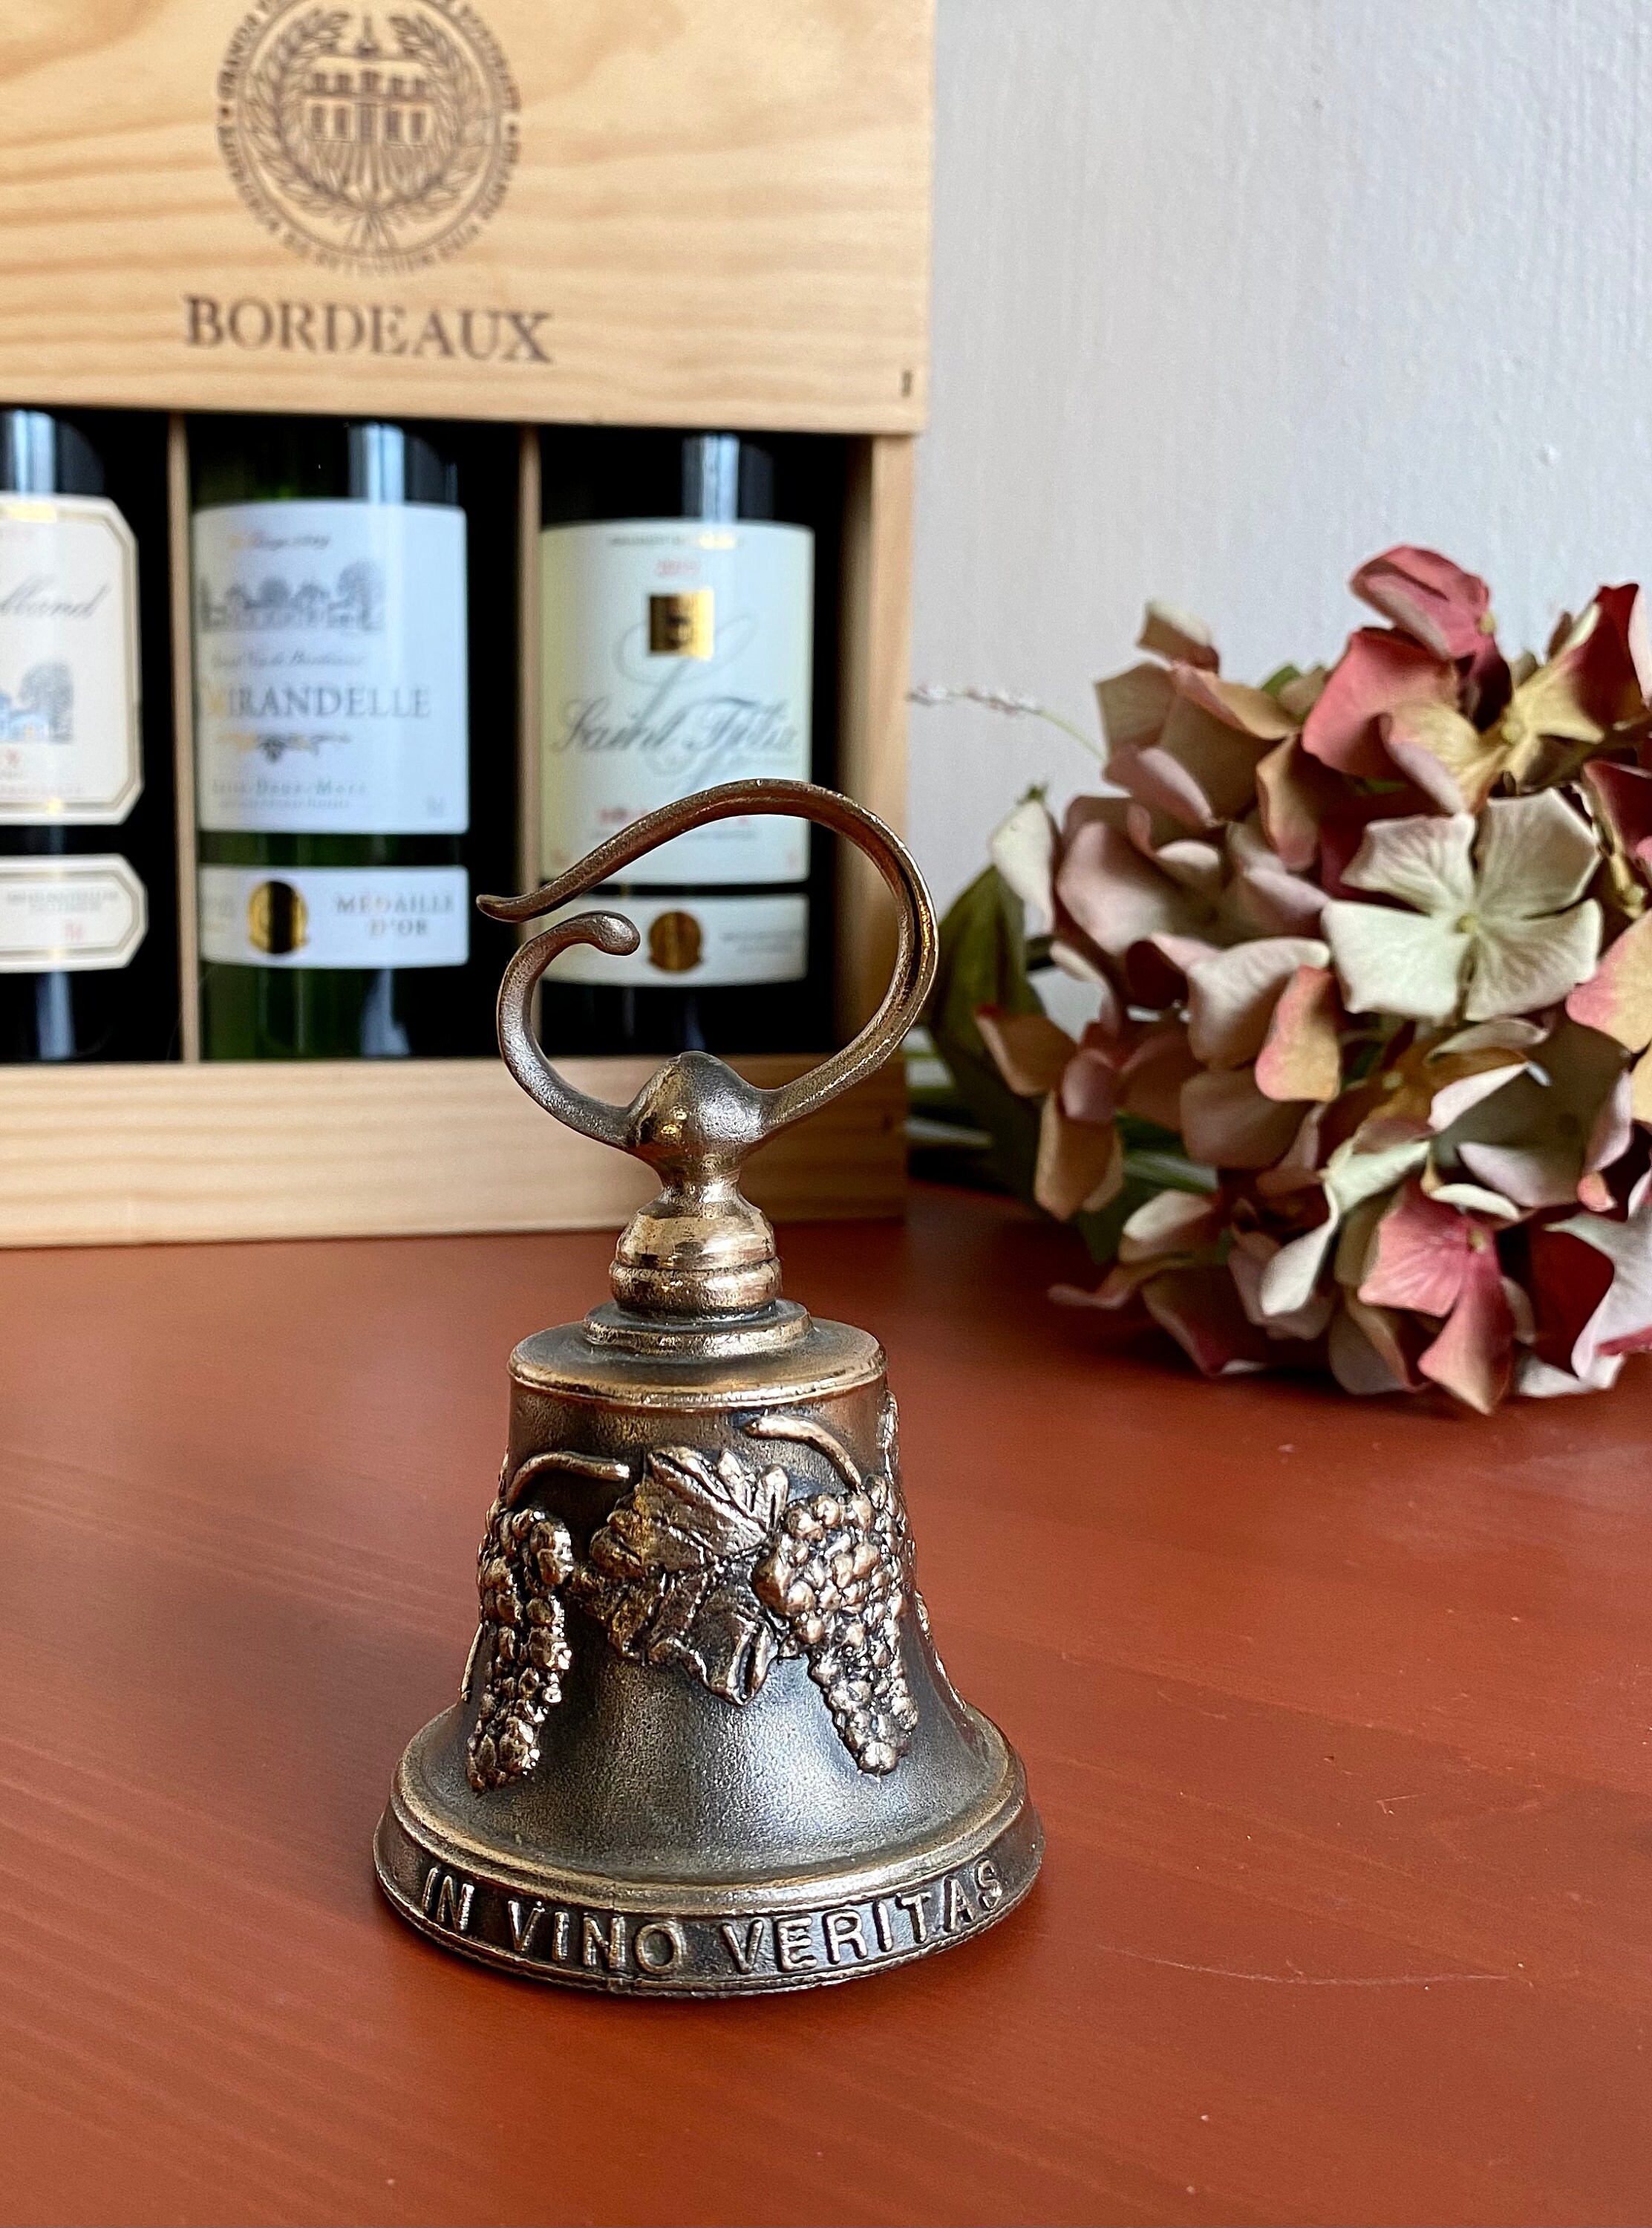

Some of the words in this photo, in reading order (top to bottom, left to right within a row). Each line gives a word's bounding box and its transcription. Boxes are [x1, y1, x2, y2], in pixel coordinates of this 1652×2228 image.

[183, 294, 554, 364] BORDEAUX
[421, 1866, 475, 1931] IN
[507, 1898, 685, 1976] VINO
[722, 1858, 1005, 1973] VERITAS
